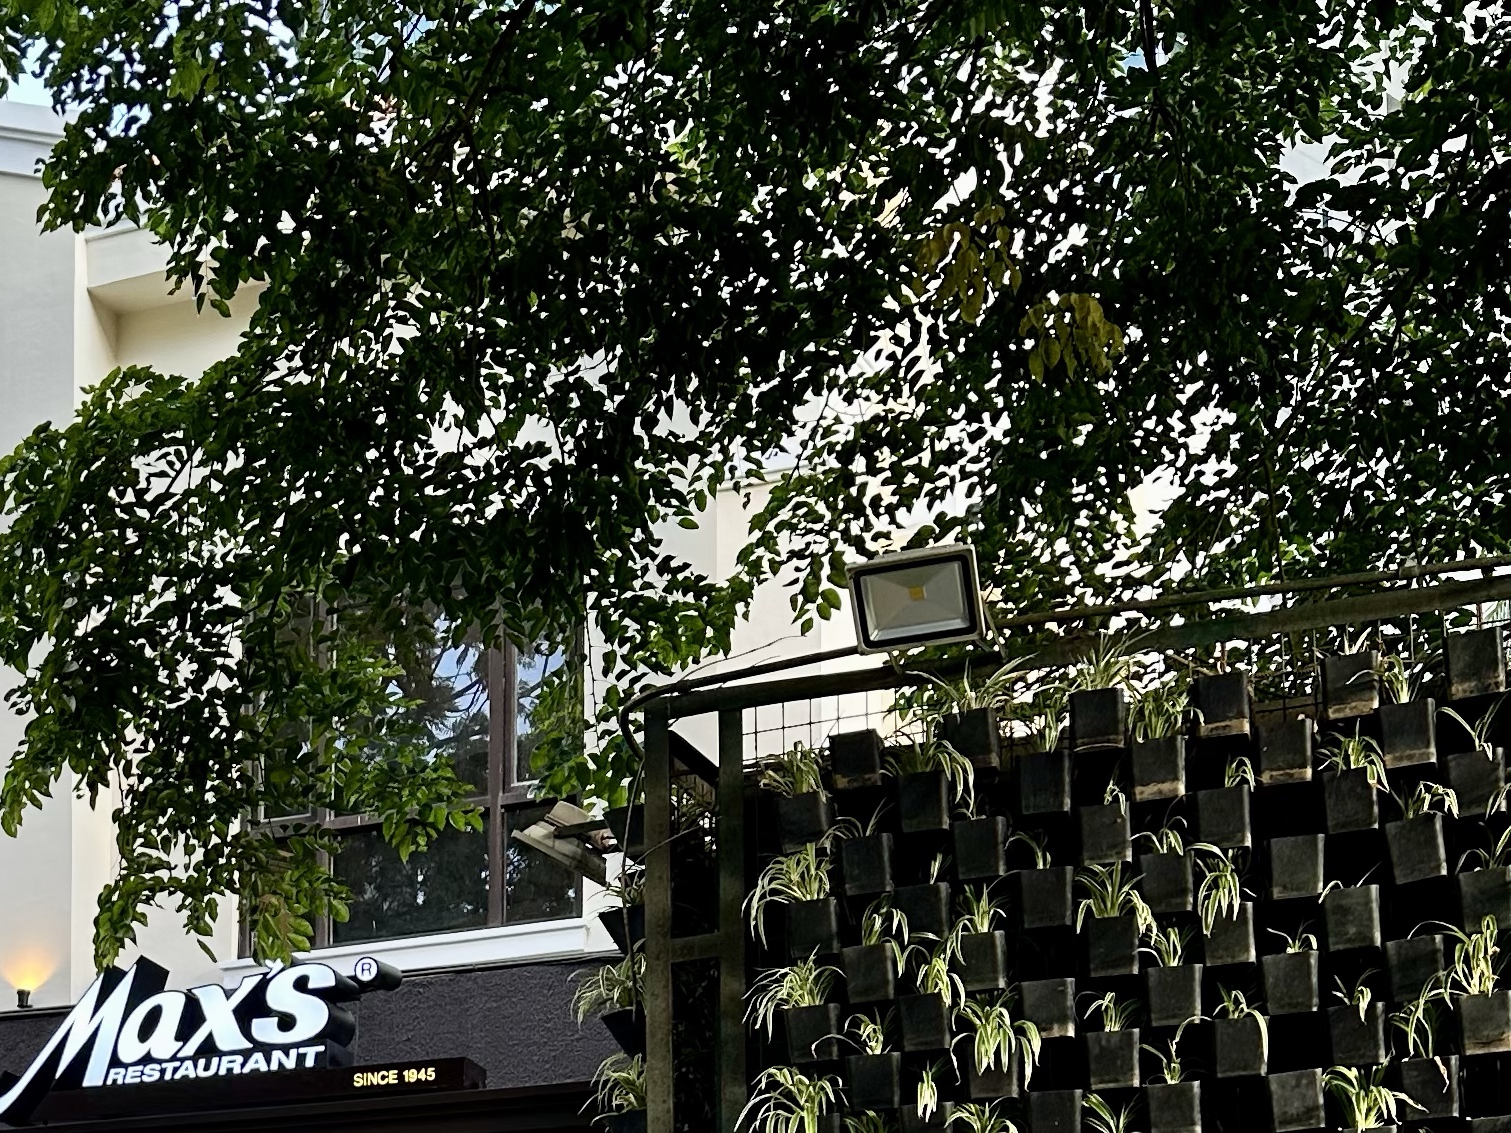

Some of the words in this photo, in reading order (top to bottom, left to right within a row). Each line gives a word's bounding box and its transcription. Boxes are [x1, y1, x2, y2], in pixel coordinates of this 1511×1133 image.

[106, 1045, 326, 1087] RESTAURANT
[353, 1070, 399, 1088] SINCE
[402, 1067, 436, 1083] 1945
